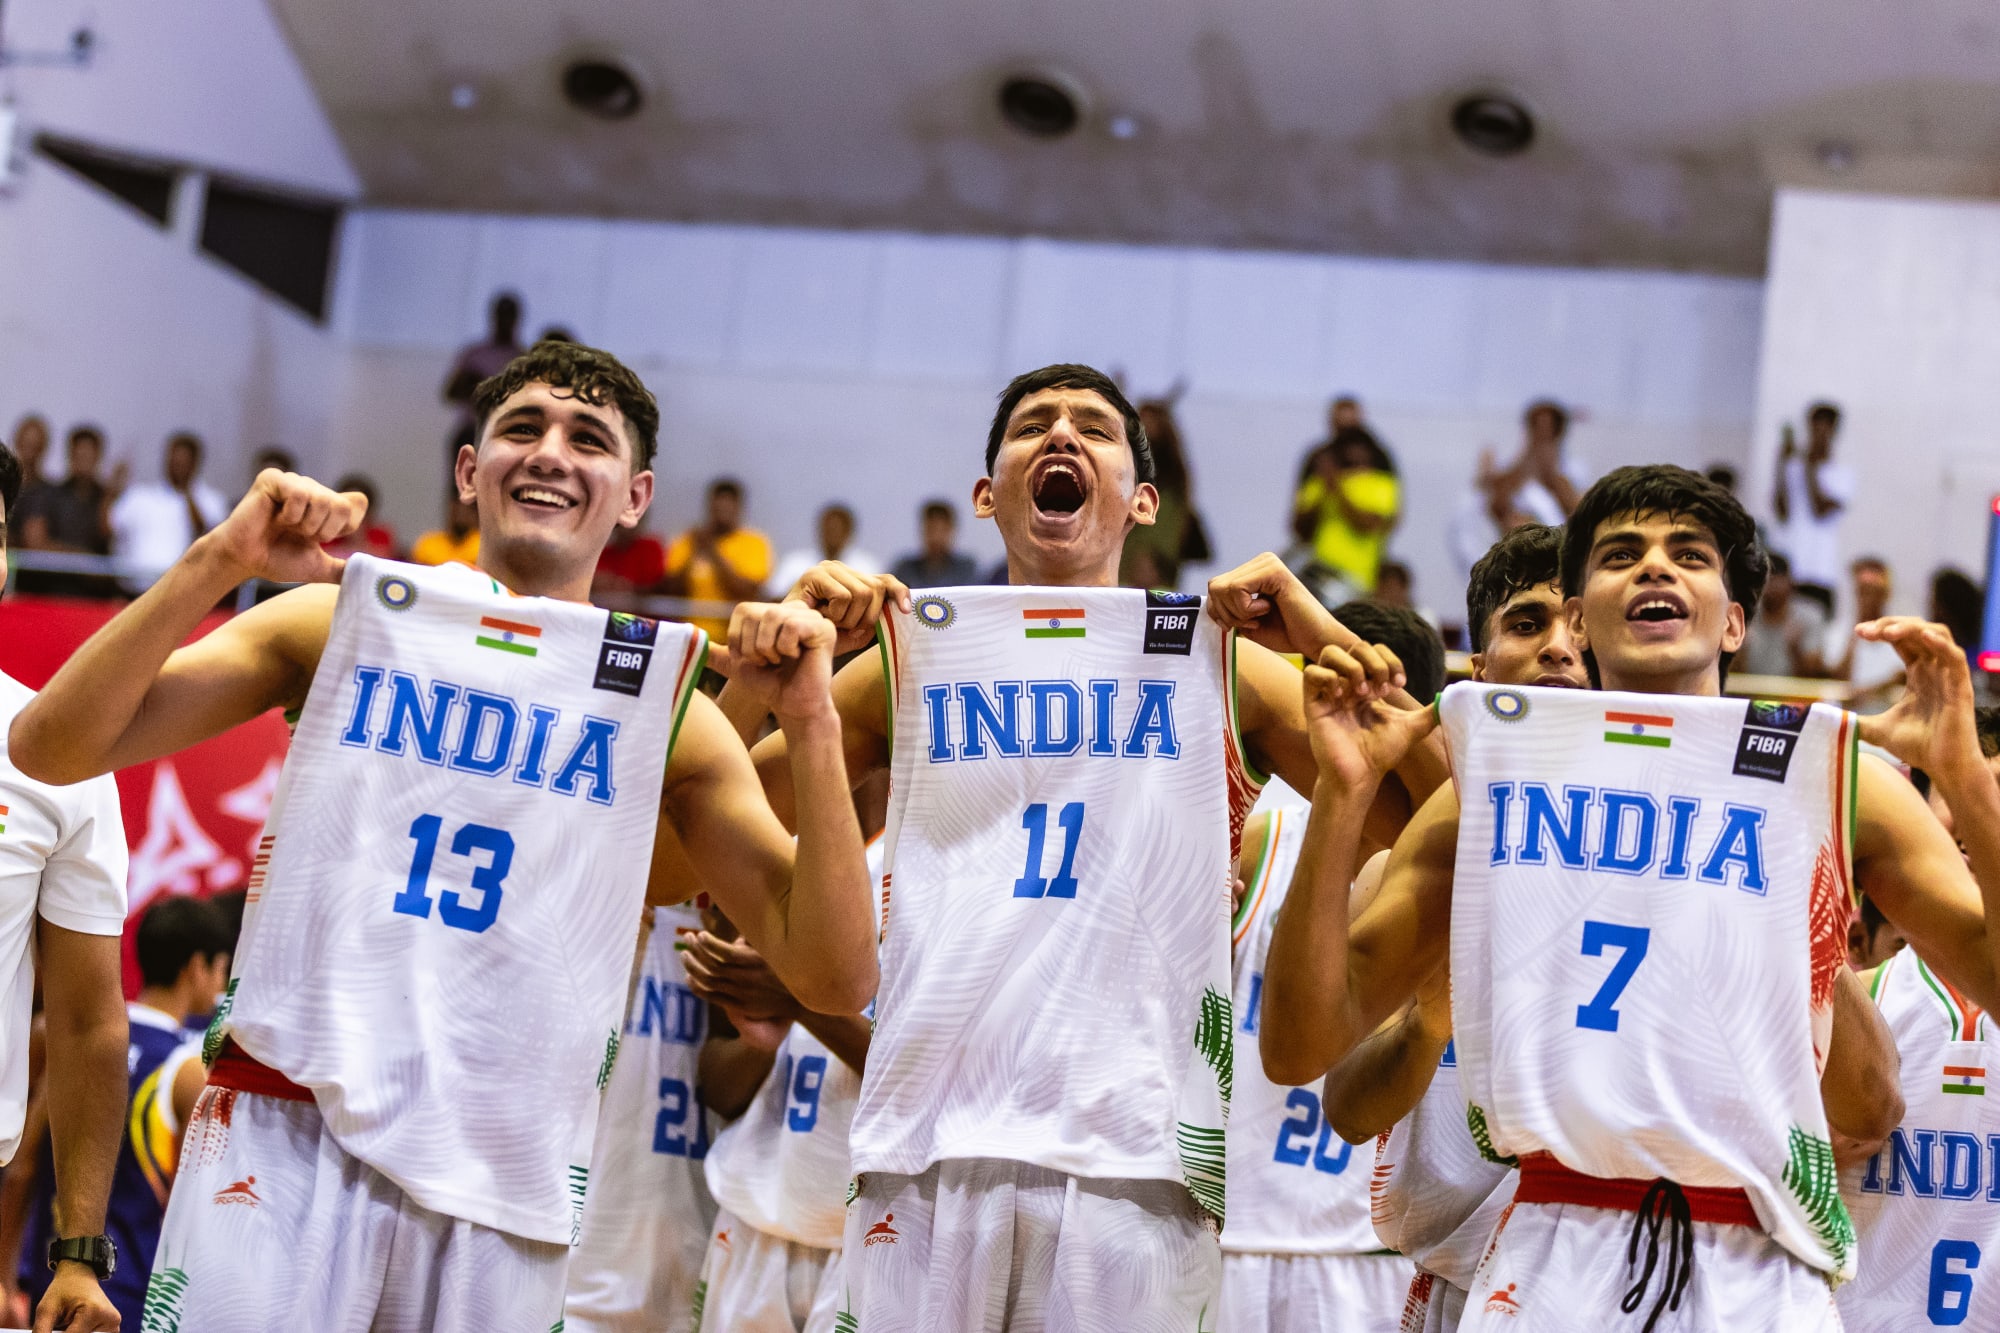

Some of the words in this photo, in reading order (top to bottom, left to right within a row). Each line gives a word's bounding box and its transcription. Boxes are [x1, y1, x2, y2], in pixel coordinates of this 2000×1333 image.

[606, 649, 643, 670] FIBA
[1153, 615, 1189, 630] FIBA
[340, 665, 620, 806] INDIA
[923, 679, 1181, 763] INDIA
[1746, 734, 1787, 756] FIBA
[393, 813, 515, 933] 13
[1013, 802, 1085, 898] 11
[1488, 781, 1769, 896] INDIA
[1576, 920, 1650, 1032] 7
[1927, 1239, 1981, 1326] 6
